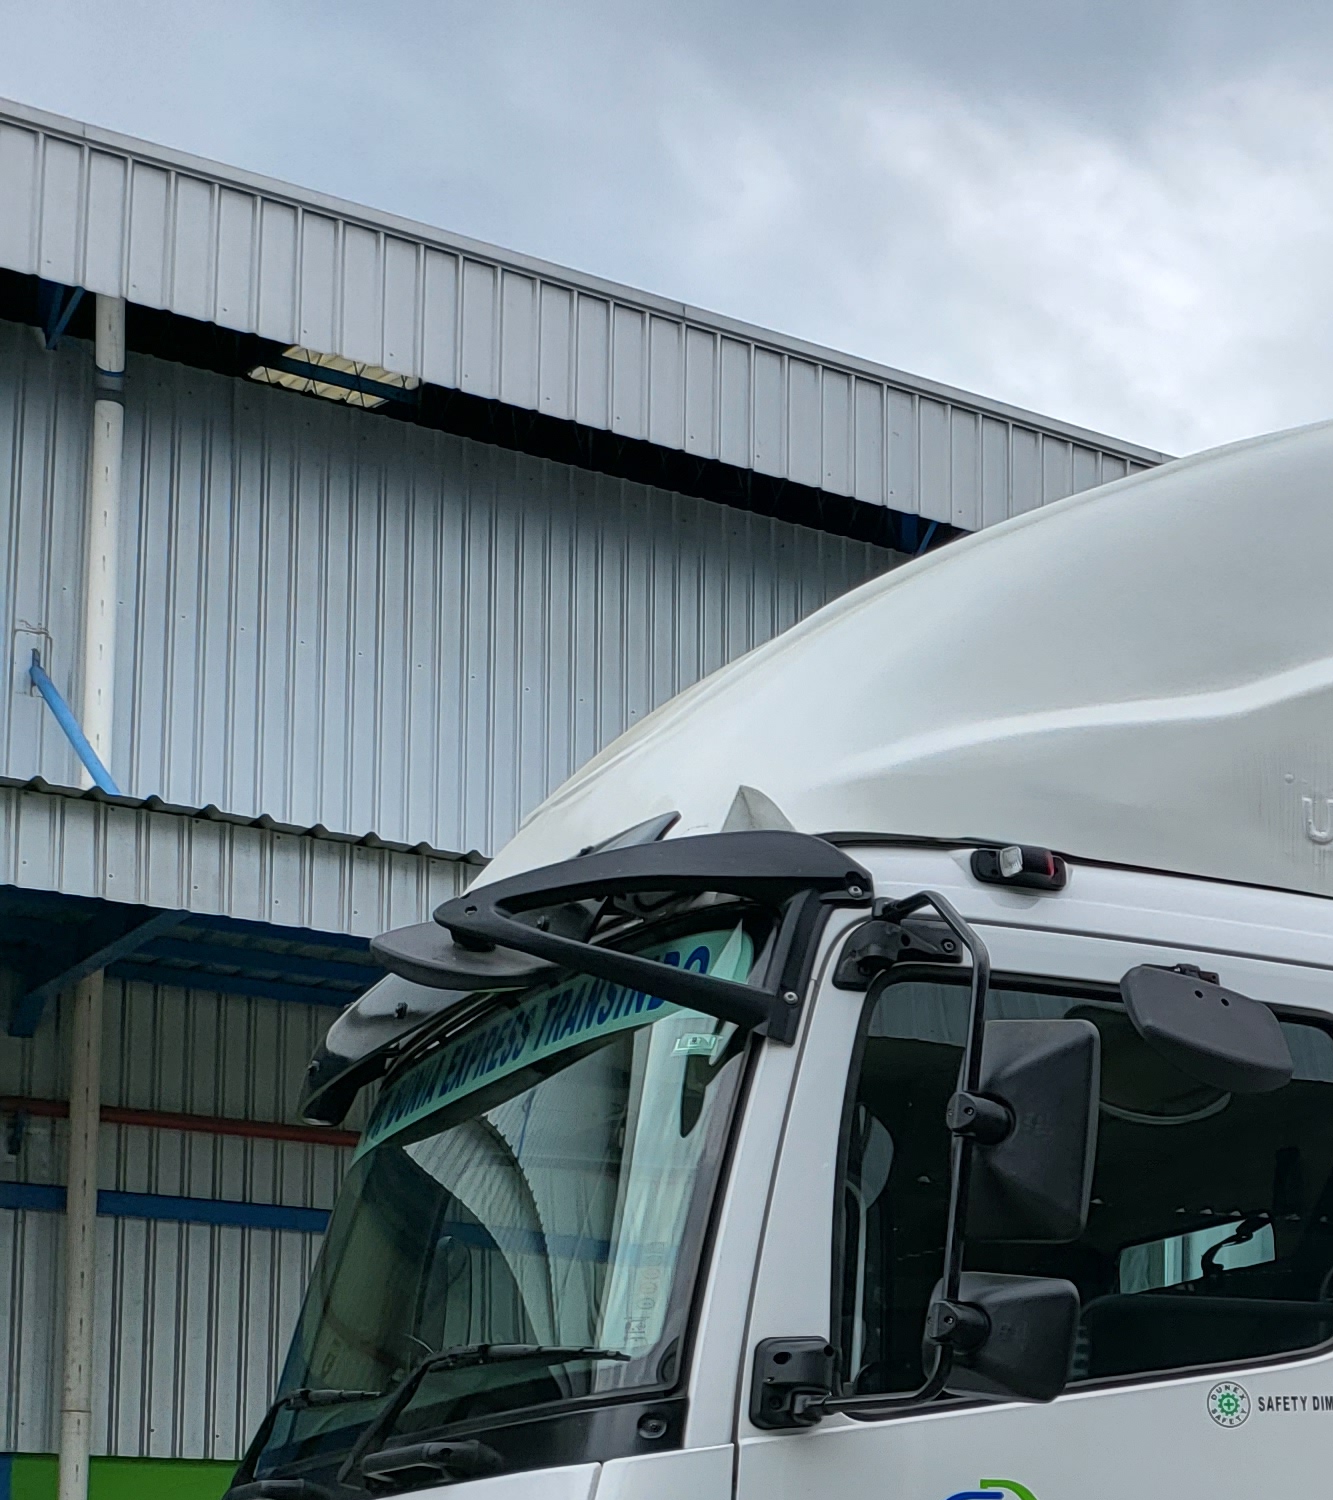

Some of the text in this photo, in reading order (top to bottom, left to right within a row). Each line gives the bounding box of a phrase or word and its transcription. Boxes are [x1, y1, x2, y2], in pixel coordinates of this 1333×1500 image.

[438, 1003, 538, 1098] EXPRESS
[1210, 1384, 1247, 1401] DUNEX
[1258, 1395, 1308, 1412] SAFETY
[1210, 1407, 1248, 1425] SAFETY
